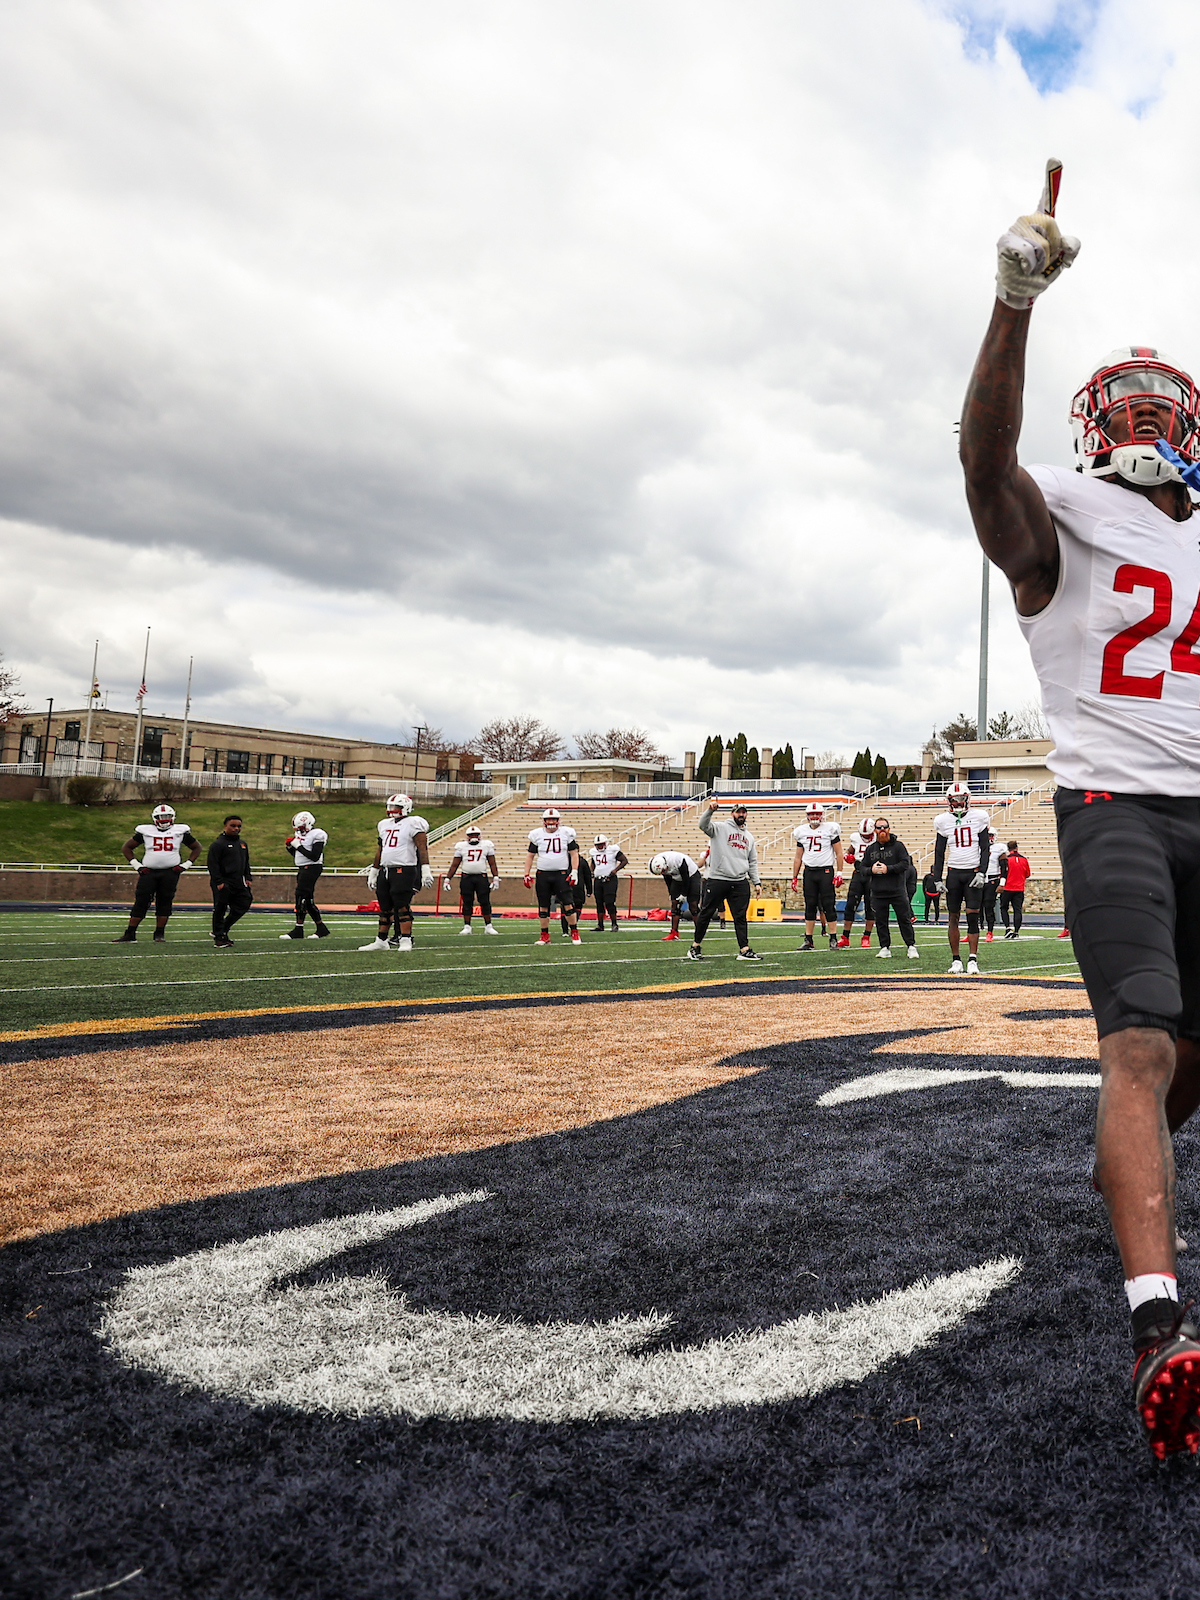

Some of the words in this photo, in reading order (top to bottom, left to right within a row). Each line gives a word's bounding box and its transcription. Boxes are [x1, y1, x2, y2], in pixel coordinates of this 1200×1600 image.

[153, 836, 174, 851] 56
[384, 829, 400, 848] 76
[806, 836, 822, 851] 75
[954, 827, 972, 848] 10
[543, 837, 562, 854] 70
[468, 849, 482, 862] 57
[595, 854, 608, 865] 54
